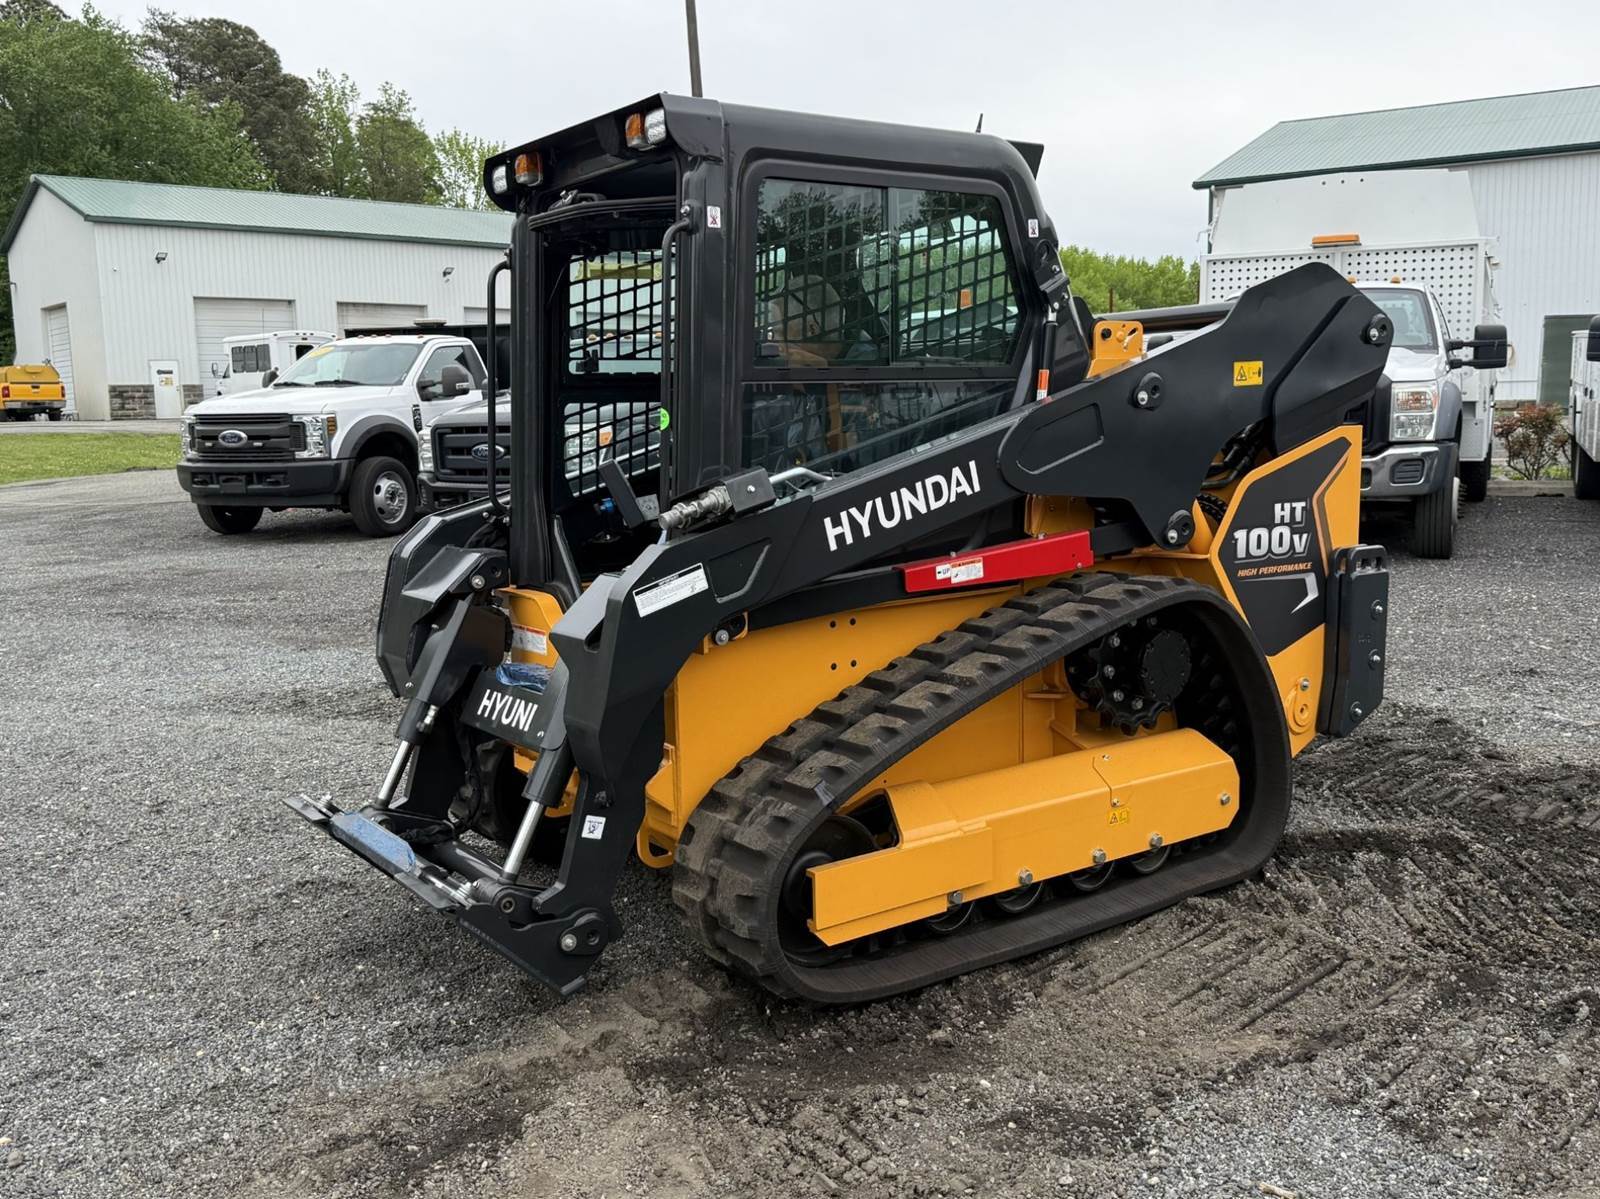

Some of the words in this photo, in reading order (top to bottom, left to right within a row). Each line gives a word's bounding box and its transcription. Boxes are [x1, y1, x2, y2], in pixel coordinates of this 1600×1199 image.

[823, 460, 981, 552] HYUNDAI
[1274, 502, 1306, 524] HT
[1237, 567, 1258, 577] HIGH
[1258, 562, 1313, 575] PERFORMANCE
